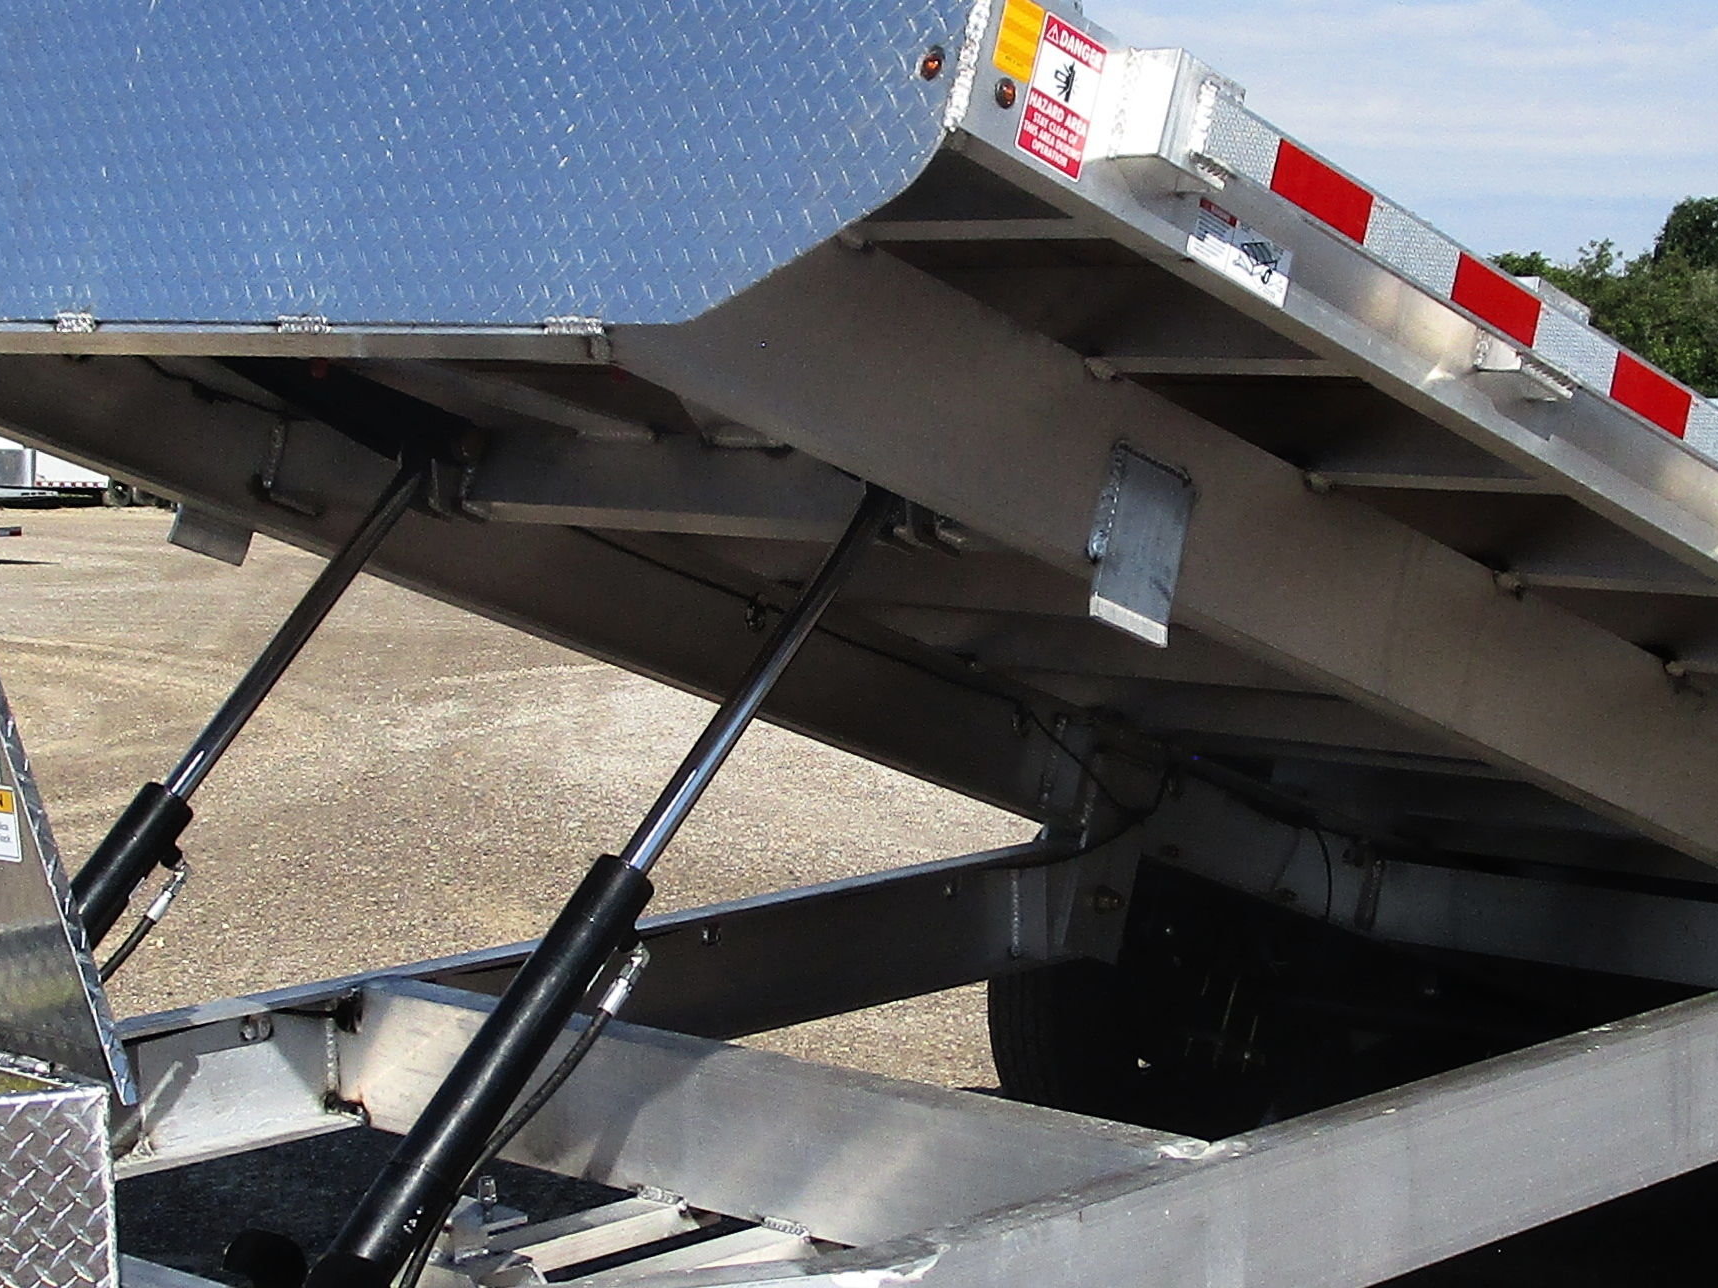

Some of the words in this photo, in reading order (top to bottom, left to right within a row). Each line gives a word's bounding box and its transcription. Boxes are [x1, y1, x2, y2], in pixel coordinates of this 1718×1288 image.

[1059, 29, 1103, 70] DANGER
[1028, 91, 1065, 123] HAZARD
[1064, 113, 1087, 137] AREA
[1038, 128, 1055, 147] AREA
[1049, 122, 1069, 142] CLEAR
[1031, 138, 1068, 169] OPERATION
